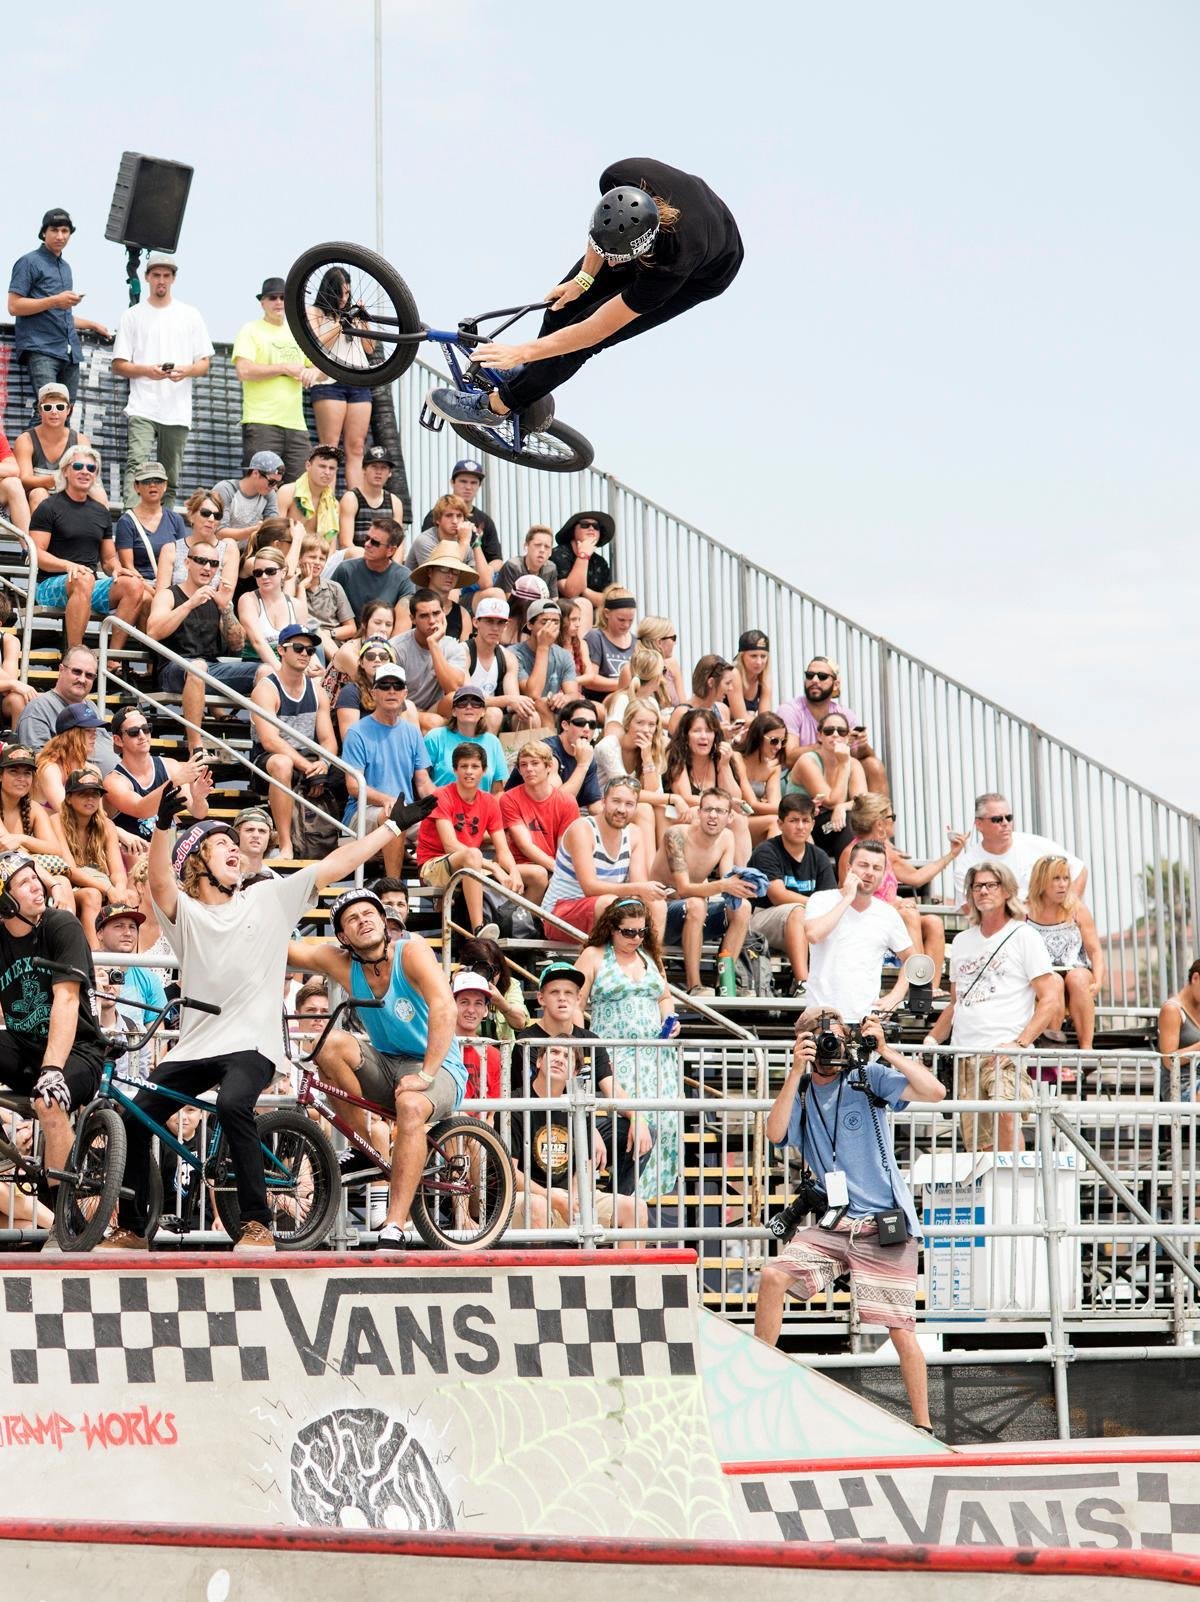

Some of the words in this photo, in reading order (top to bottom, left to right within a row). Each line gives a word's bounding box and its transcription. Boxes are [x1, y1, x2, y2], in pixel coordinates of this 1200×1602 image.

[0, 956, 33, 991] INDEX
[997, 1153, 1075, 1169] RCLE
[270, 1277, 500, 1376] VANS
[3, 1412, 75, 1451] RAMP
[80, 1405, 179, 1451] WORKS
[875, 1471, 1133, 1550] VANS
